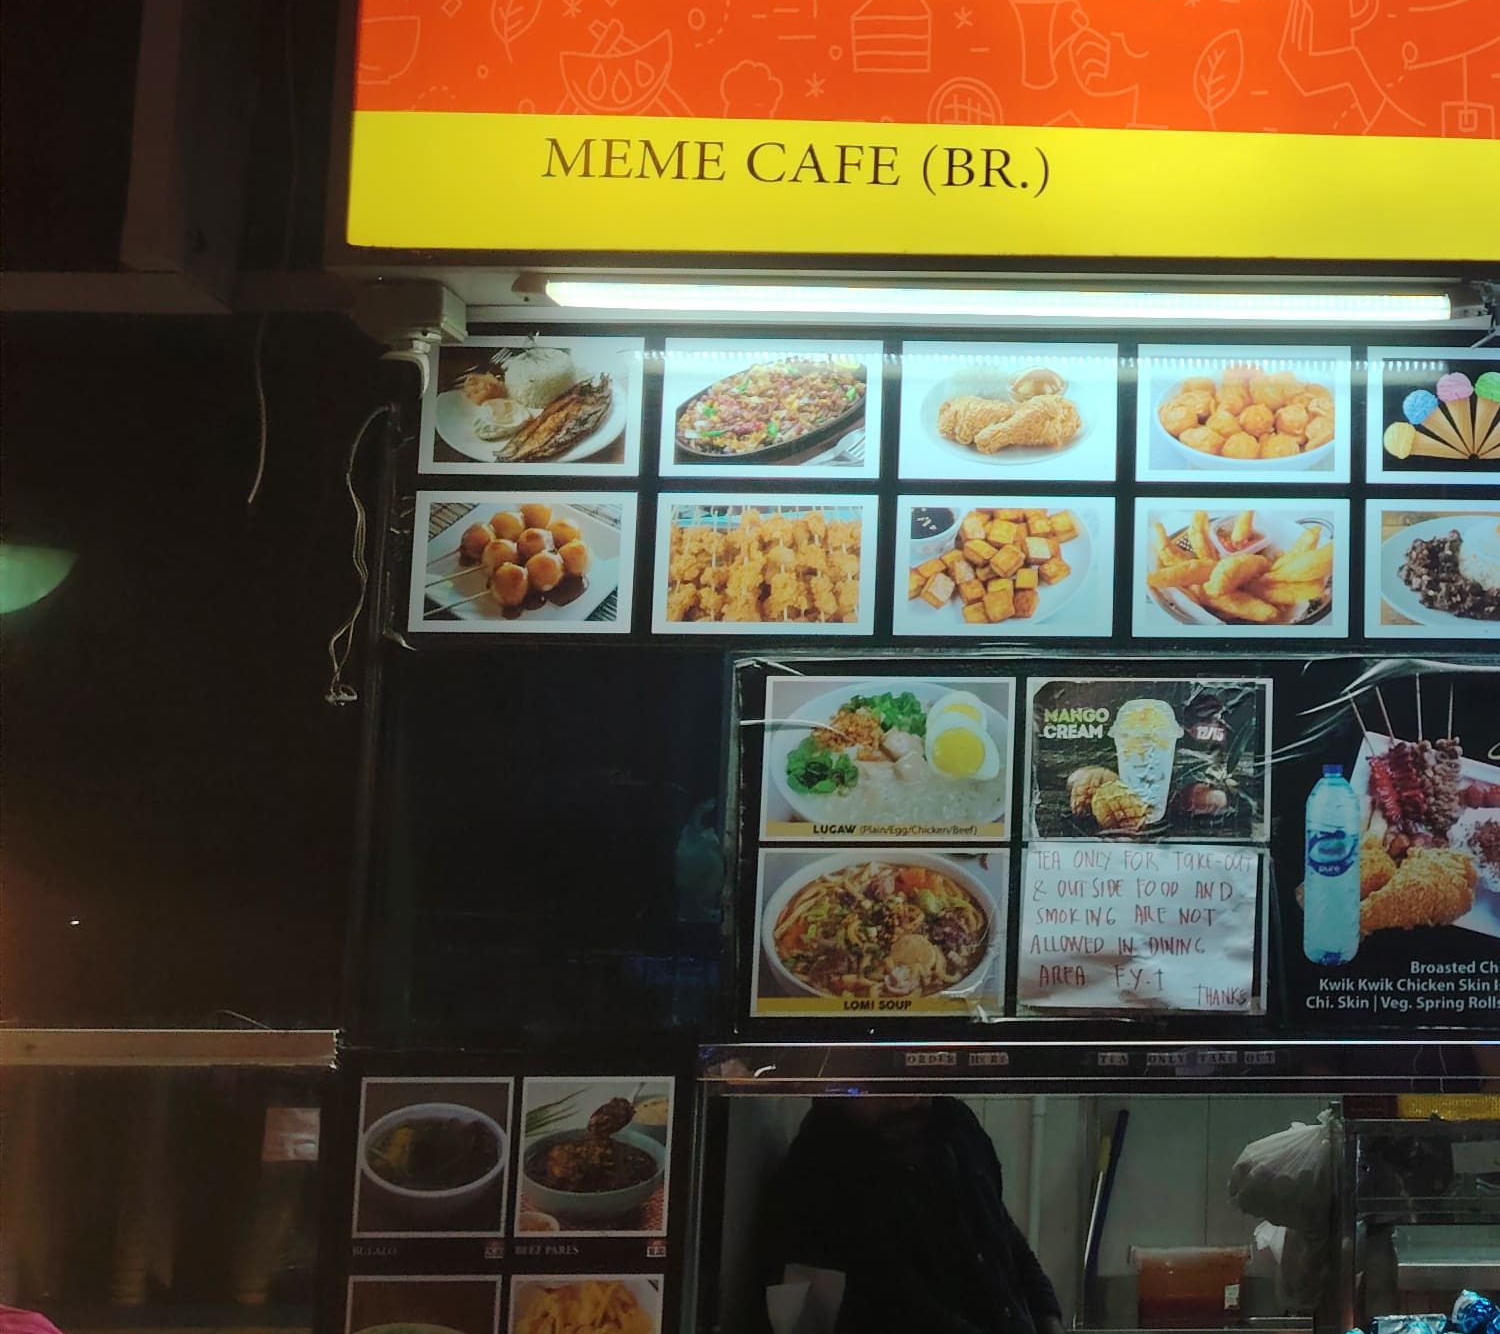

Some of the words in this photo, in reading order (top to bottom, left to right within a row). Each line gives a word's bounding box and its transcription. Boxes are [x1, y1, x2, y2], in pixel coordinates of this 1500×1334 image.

[541, 136, 728, 185] MEME
[745, 141, 902, 189] CAFE
[920, 144, 1052, 199] (BR.)
[1044, 707, 1110, 724] MANGO
[1043, 724, 1104, 740] CREAM
[813, 824, 857, 836] LUGAW
[1033, 851, 1061, 871] TEA
[1073, 850, 1112, 871] ONLY
[1124, 851, 1158, 871] FOR
[1194, 880, 1233, 902] AND
[1133, 904, 1168, 925] ARE
[1179, 907, 1216, 927] NOT
[1030, 934, 1105, 956] ALLOWED
[1118, 936, 1134, 956] IN
[1039, 964, 1086, 988] AREA
[1410, 961, 1477, 975] Broasted
[1319, 978, 1355, 992] Kwik
[1358, 978, 1393, 992] Kwik
[1396, 978, 1456, 992] Chicken
[1458, 978, 1491, 992] Skin
[1192, 983, 1249, 1007] THANKS
[1305, 995, 1334, 1009] Chi.
[1337, 995, 1370, 1009] Skin
[1381, 995, 1413, 1012] Veg.
[1416, 995, 1465, 1012] Spring
[843, 999, 875, 1012] LOMI
[877, 999, 912, 1012] SOUP
